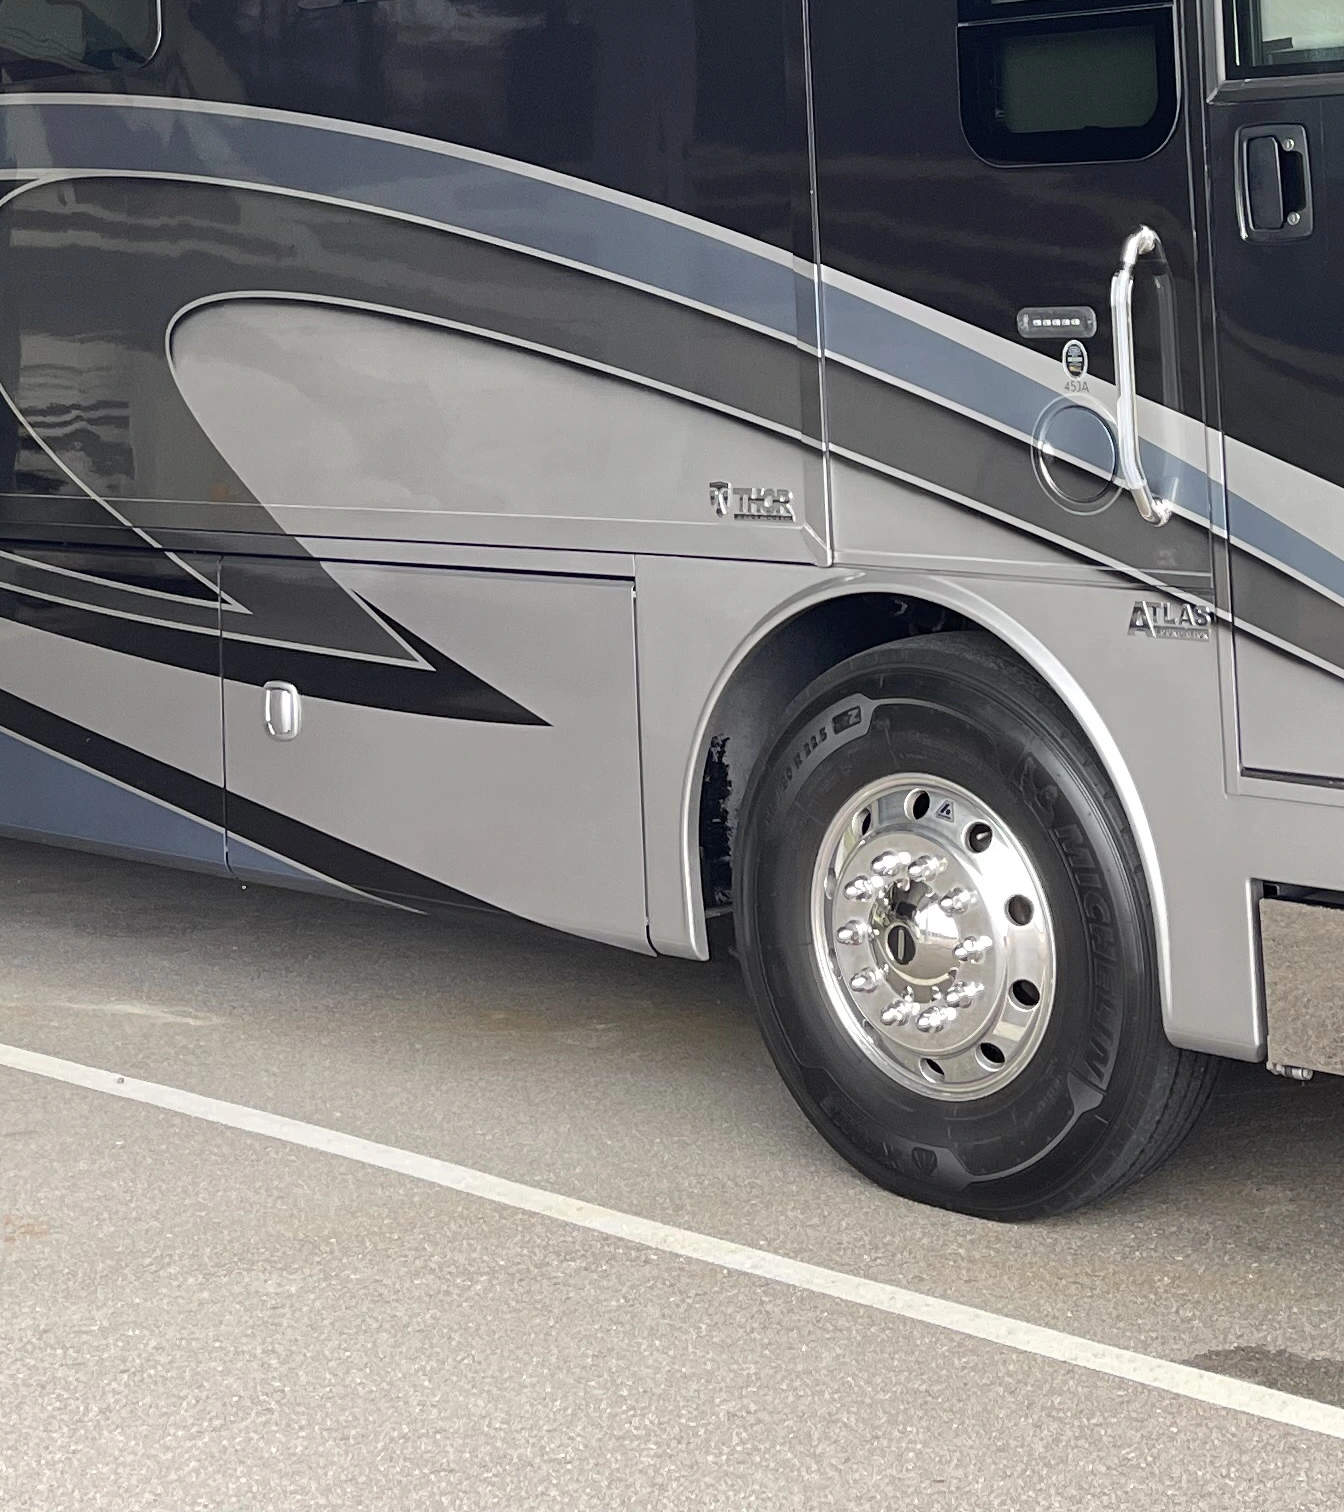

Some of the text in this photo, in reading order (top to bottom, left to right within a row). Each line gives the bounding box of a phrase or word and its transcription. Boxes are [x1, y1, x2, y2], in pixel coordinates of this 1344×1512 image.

[733, 487, 796, 520] THOR
[1127, 600, 1211, 638] ATLAS
[1053, 822, 1122, 1091] MICHELIN
